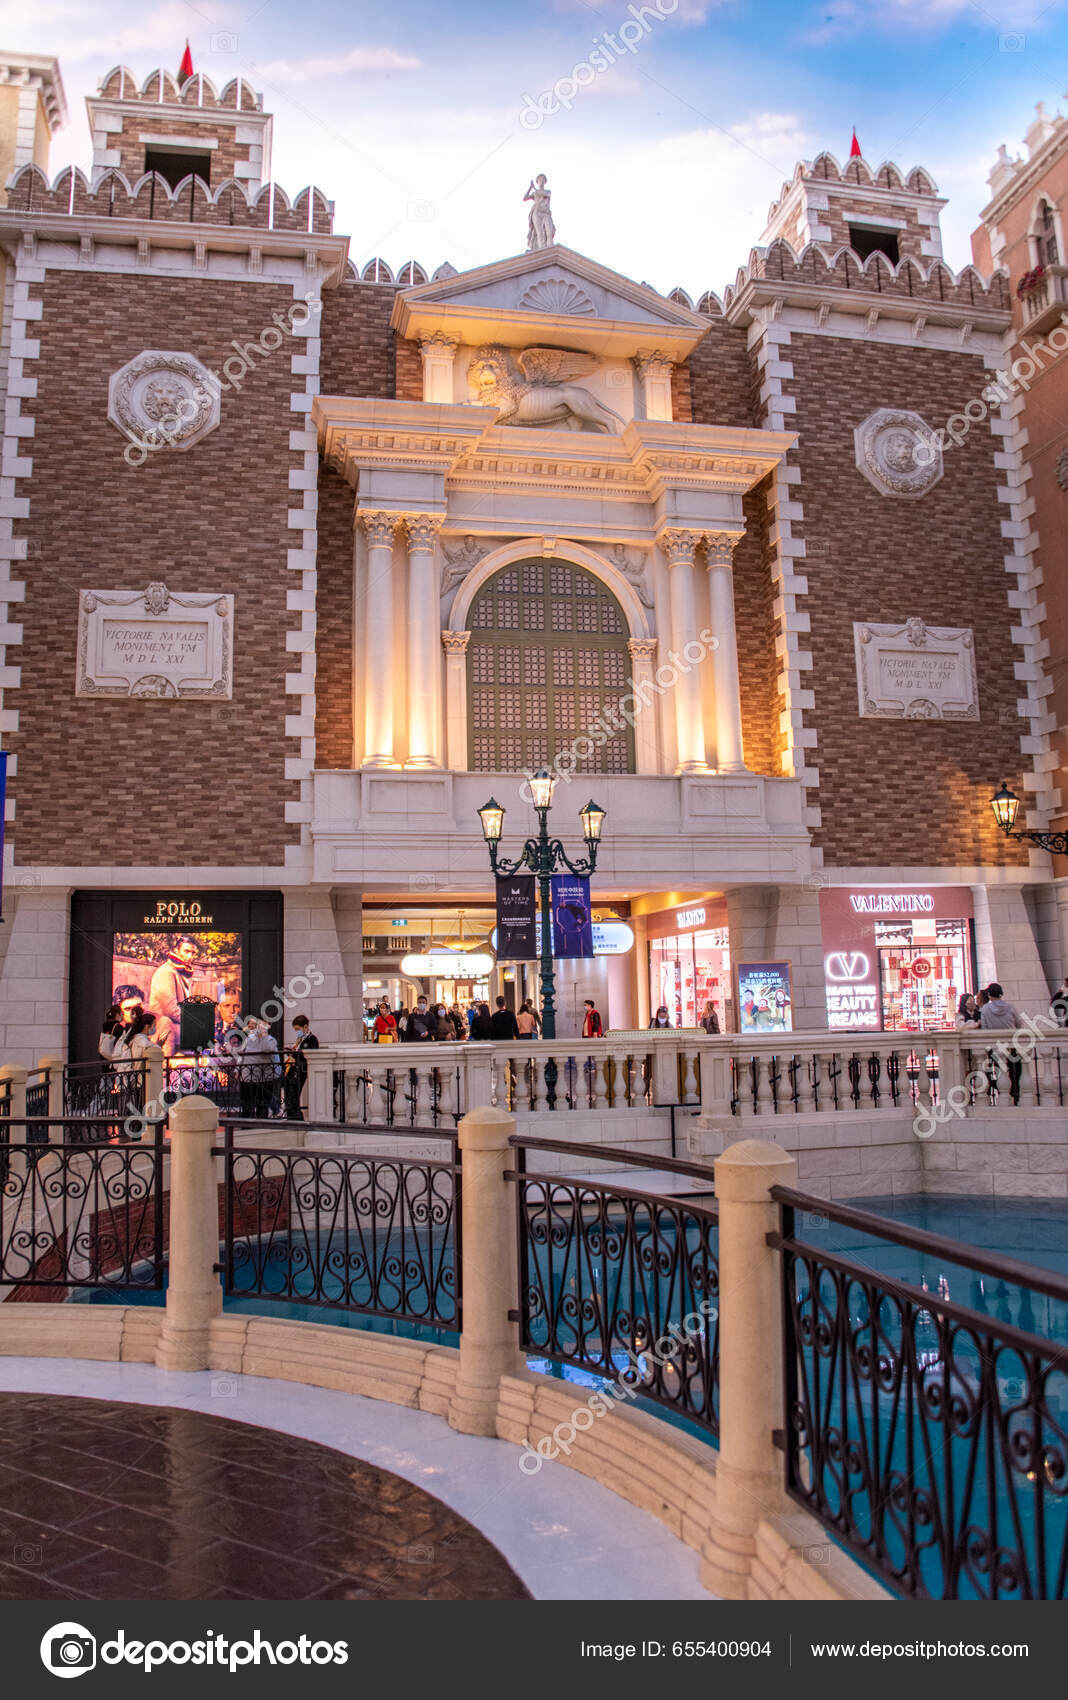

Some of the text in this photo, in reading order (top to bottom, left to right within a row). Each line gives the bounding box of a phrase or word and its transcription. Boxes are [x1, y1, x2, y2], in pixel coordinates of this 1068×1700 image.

[105, 630, 205, 641] VICTORIE NAVALIS
[113, 641, 197, 653] MONIMENT VM
[122, 653, 134, 663] M
[165, 654, 184, 664] XXI
[849, 894, 935, 912] VALENTINO
[156, 902, 201, 916] POLO
[143, 916, 213, 924] RALPH LAUREN
